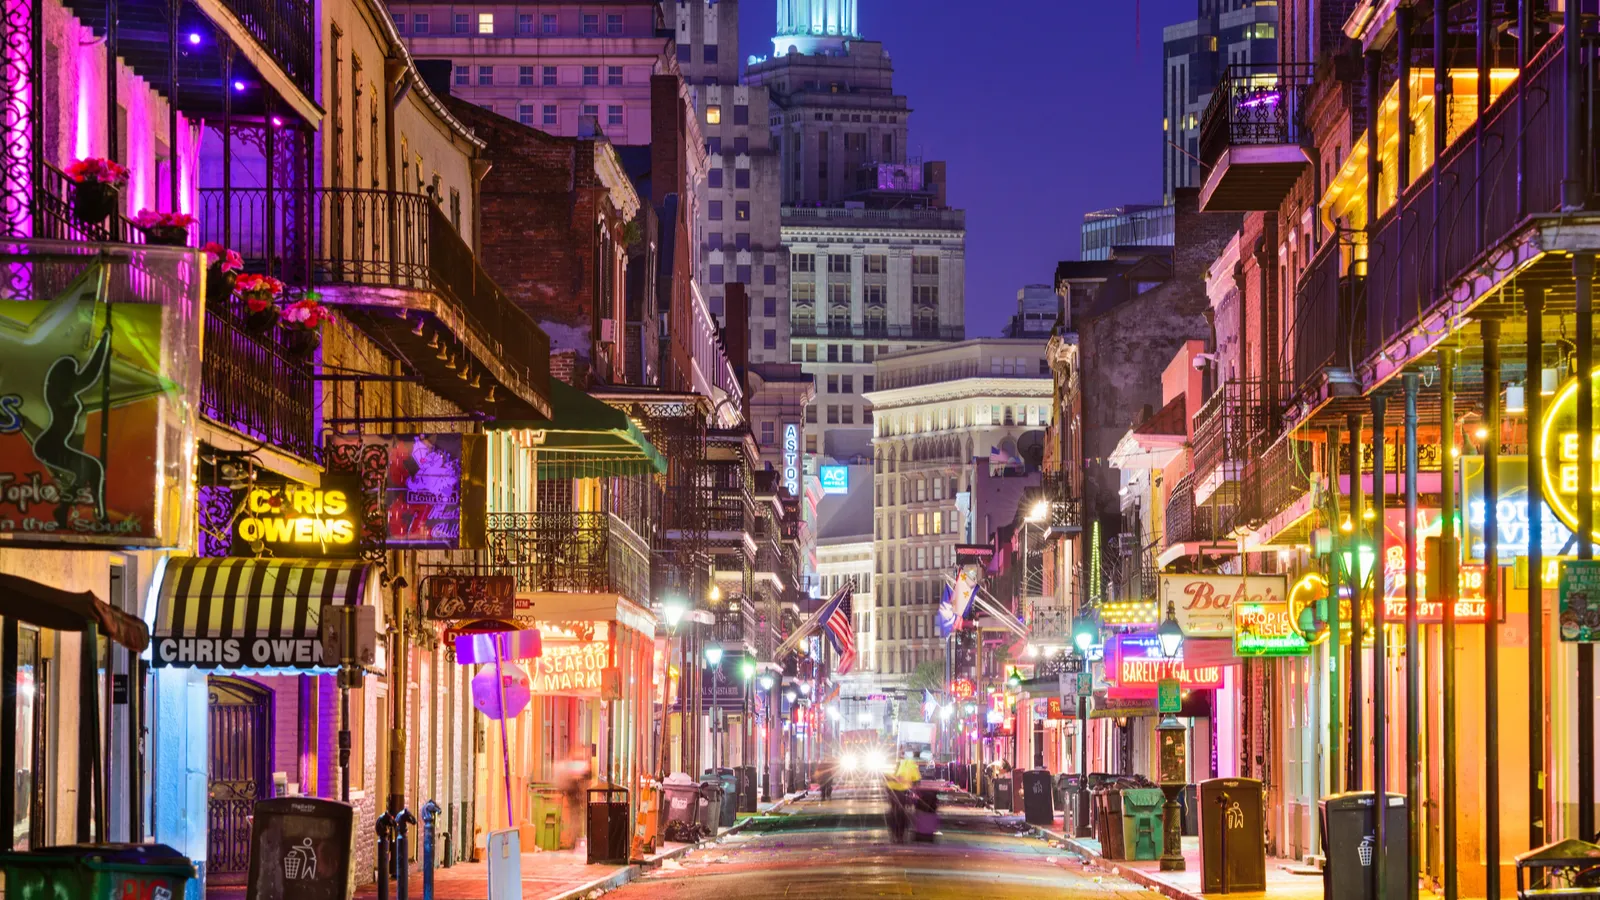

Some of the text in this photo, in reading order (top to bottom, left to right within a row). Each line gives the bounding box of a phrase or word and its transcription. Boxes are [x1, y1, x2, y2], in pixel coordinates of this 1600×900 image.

[786, 424, 797, 495] ASTOR
[824, 469, 845, 481] AC
[23, 518, 59, 532] the
[239, 517, 354, 543] OWENS
[1386, 602, 1419, 616] PIZ
[1421, 602, 1435, 616] BY
[1240, 611, 1288, 625] TROPIC
[1260, 623, 1288, 635] ISLE
[159, 639, 323, 663] CHRIS OWEN
[1123, 661, 1219, 682] BARELY LGAL CLUB
[544, 671, 602, 692] MARK
